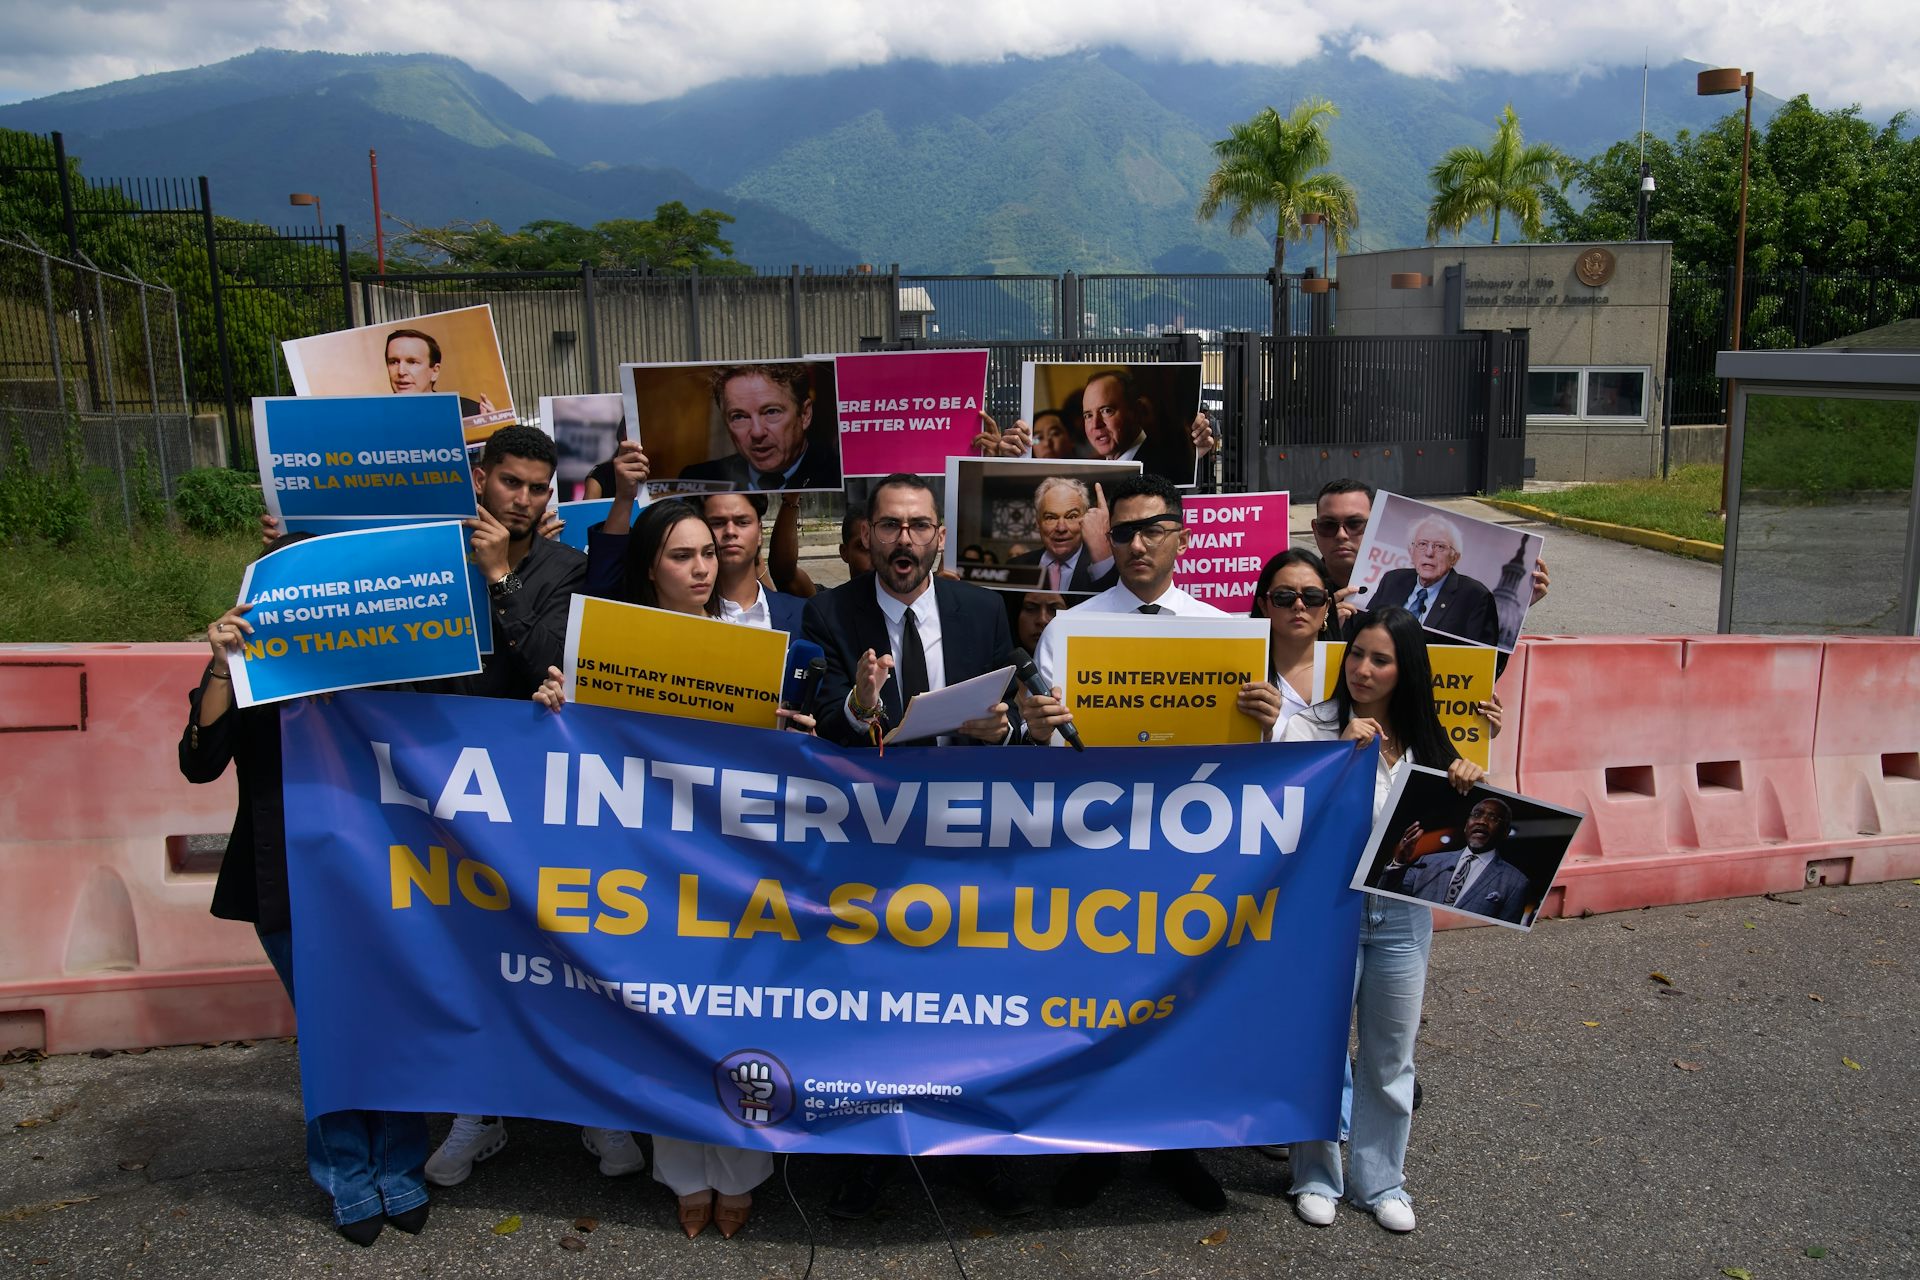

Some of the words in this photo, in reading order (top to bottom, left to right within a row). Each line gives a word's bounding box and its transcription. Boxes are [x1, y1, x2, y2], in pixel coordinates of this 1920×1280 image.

[1465, 279, 1513, 289] Embassy
[1519, 279, 1530, 288] of
[1536, 278, 1554, 288] the
[1503, 295, 1540, 304] States
[1545, 295, 1558, 304] of
[1563, 295, 1609, 304] America
[874, 398, 909, 412] HAS
[912, 397, 936, 411] TO
[939, 397, 961, 410] BE
[964, 397, 977, 409] A
[839, 418, 904, 433] BETTER
[908, 417, 950, 431] WAY!
[272, 452, 321, 467] PERO
[326, 452, 353, 466] NO
[358, 448, 464, 465] QUEREMOS
[275, 476, 311, 491] SER
[314, 475, 340, 489] LA
[344, 473, 408, 488] NUEVA
[411, 471, 464, 485] LIBIA
[676, 482, 708, 492] PAUL
[1183, 509, 1198, 524] E
[1203, 506, 1263, 524] DON'T
[1188, 532, 1245, 549] WANT
[1173, 556, 1262, 574] ANOTHER
[251, 581, 350, 605] ¿ANOTHER
[259, 611, 279, 626] IN
[284, 603, 350, 623] SOUTH
[354, 593, 448, 616] AMERICA?
[245, 637, 288, 662] NO
[293, 625, 399, 654] THANK
[403, 616, 473, 641] YOU!
[577, 658, 595, 670] US
[599, 661, 668, 683] MILITARY
[671, 674, 780, 704] INTERVENTION
[1077, 670, 1103, 685] US
[1107, 671, 1252, 686] INTERVENTION
[576, 676, 588, 687] IS
[592, 679, 623, 693] NOT
[626, 684, 655, 699] THE
[658, 690, 735, 713] SOLUTION
[1076, 694, 1145, 709] MEANS
[1150, 694, 1217, 708] CHAOS
[370, 740, 512, 824] LA
[543, 751, 1305, 855] INTERVENCIÓN
[390, 844, 511, 912] NO
[537, 866, 649, 936] ES
[677, 873, 801, 942] LA
[826, 874, 1280, 956] SOLUCIÓN
[500, 952, 553, 983] US
[564, 962, 869, 1021] INTERVENTION
[880, 991, 1029, 1027] MEANS
[1041, 995, 1176, 1029] CHAOS
[804, 1079, 861, 1093] Centro
[865, 1080, 963, 1096] Venezolano
[804, 1097, 825, 1109] de
